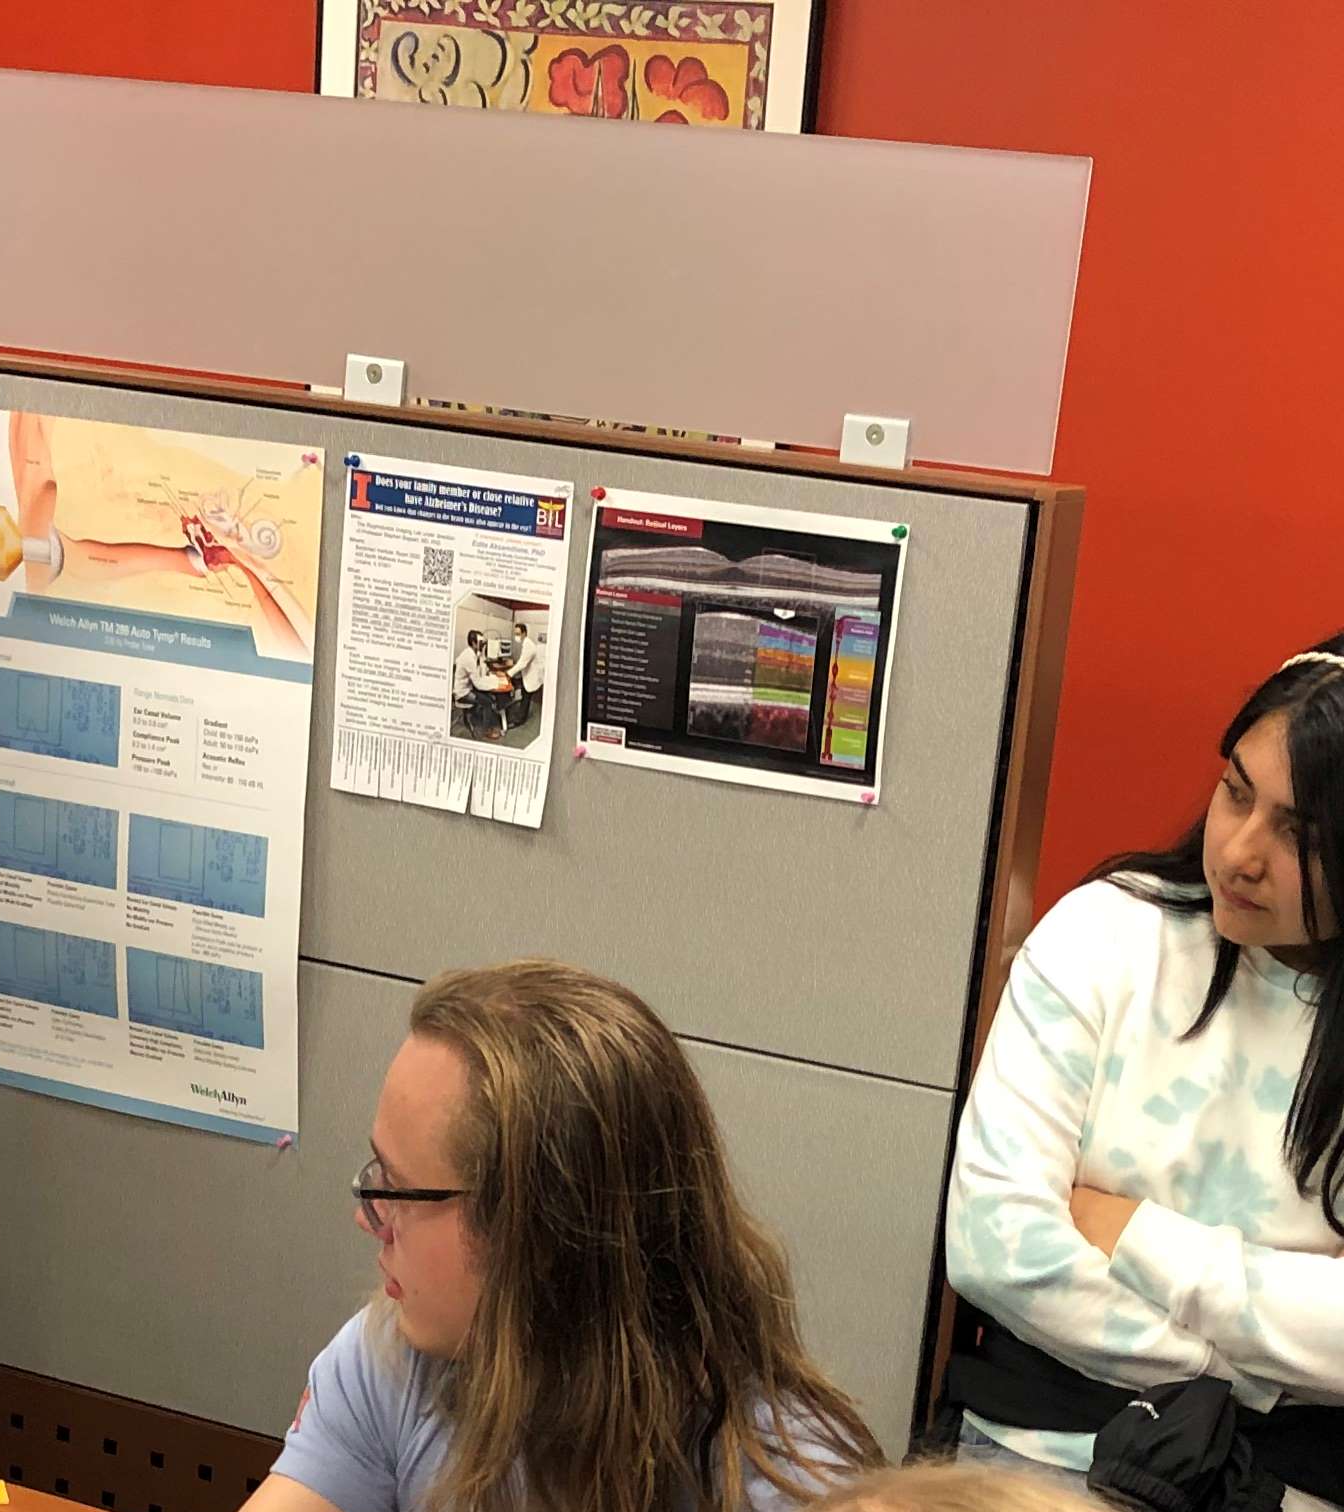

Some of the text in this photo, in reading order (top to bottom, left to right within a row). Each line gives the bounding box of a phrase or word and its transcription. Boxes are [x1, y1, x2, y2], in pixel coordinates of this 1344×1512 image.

[375, 474, 535, 507] Does your family member or close relative
[405, 493, 502, 517] have Alzheimer's Disease?
[131, 626, 151, 639] Auto
[180, 633, 212, 649] Results
